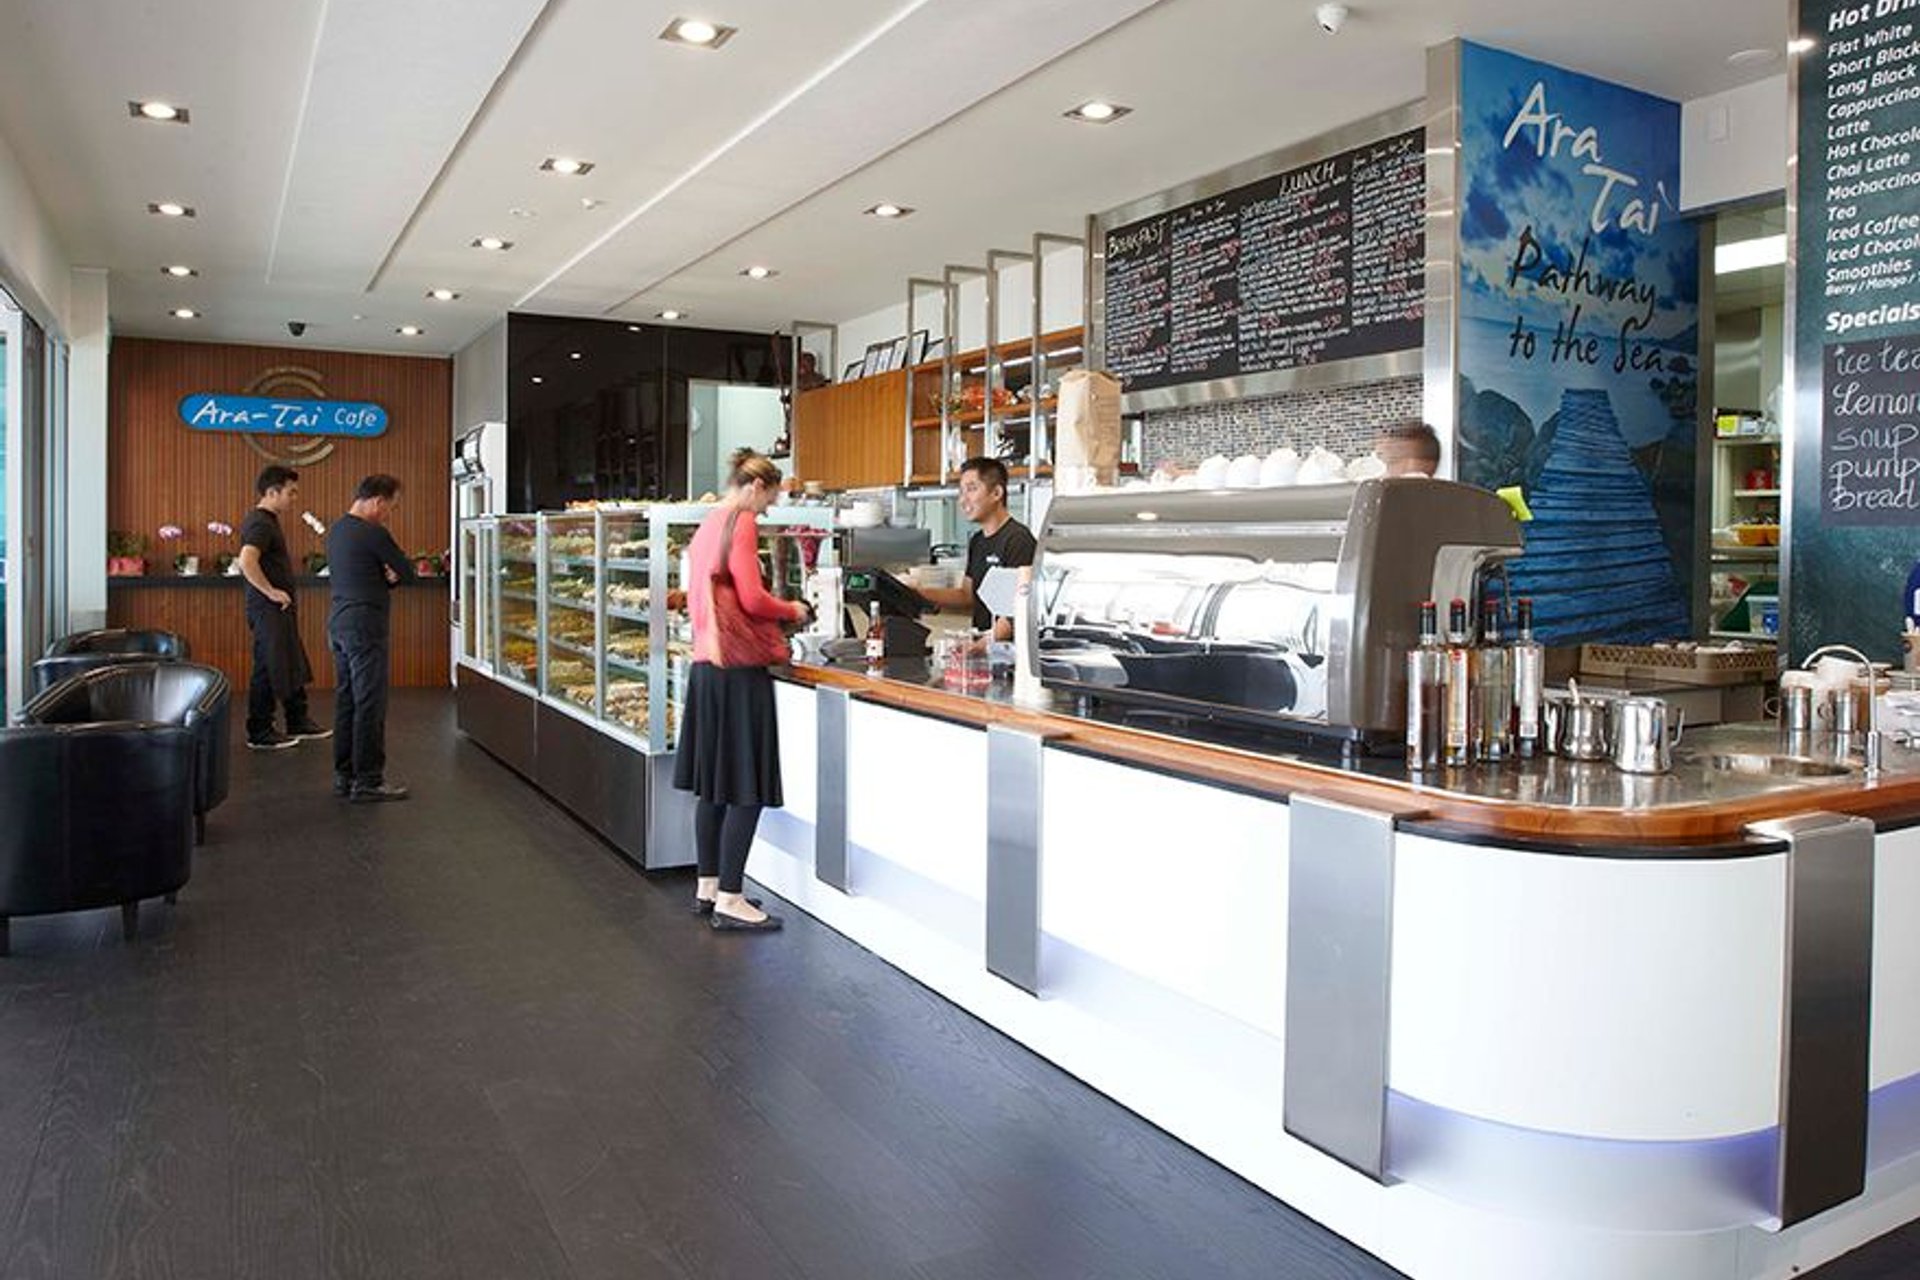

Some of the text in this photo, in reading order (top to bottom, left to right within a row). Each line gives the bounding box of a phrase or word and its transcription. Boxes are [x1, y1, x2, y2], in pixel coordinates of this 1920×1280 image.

[1828, 4, 1870, 32] Hot
[1828, 24, 1913, 59] Flat White
[1828, 41, 1920, 79] Short Black
[1828, 63, 1917, 99] Long Black
[1828, 87, 1920, 119] Cappuccino
[1503, 81, 1602, 162] Ara
[1828, 120, 1870, 140] Latte
[1827, 142, 1857, 160] Hot
[1827, 152, 1910, 181] Chai Latte
[1827, 172, 1920, 201] Mochaccino
[1826, 214, 1920, 242] Iced Coffee
[1828, 206, 1857, 221] Tea
[1826, 244, 1860, 263] Iced
[1510, 225, 1656, 330] Pathway
[1826, 257, 1912, 284] Smoothies
[1825, 282, 1857, 296] Berry
[1866, 277, 1908, 290] Mango
[1825, 302, 1920, 334] Specials
[1510, 304, 1664, 373] to the Sea
[1834, 345, 1873, 376] ice
[191, 399, 322, 429] Ara-Tai
[1831, 423, 1919, 474] soup
